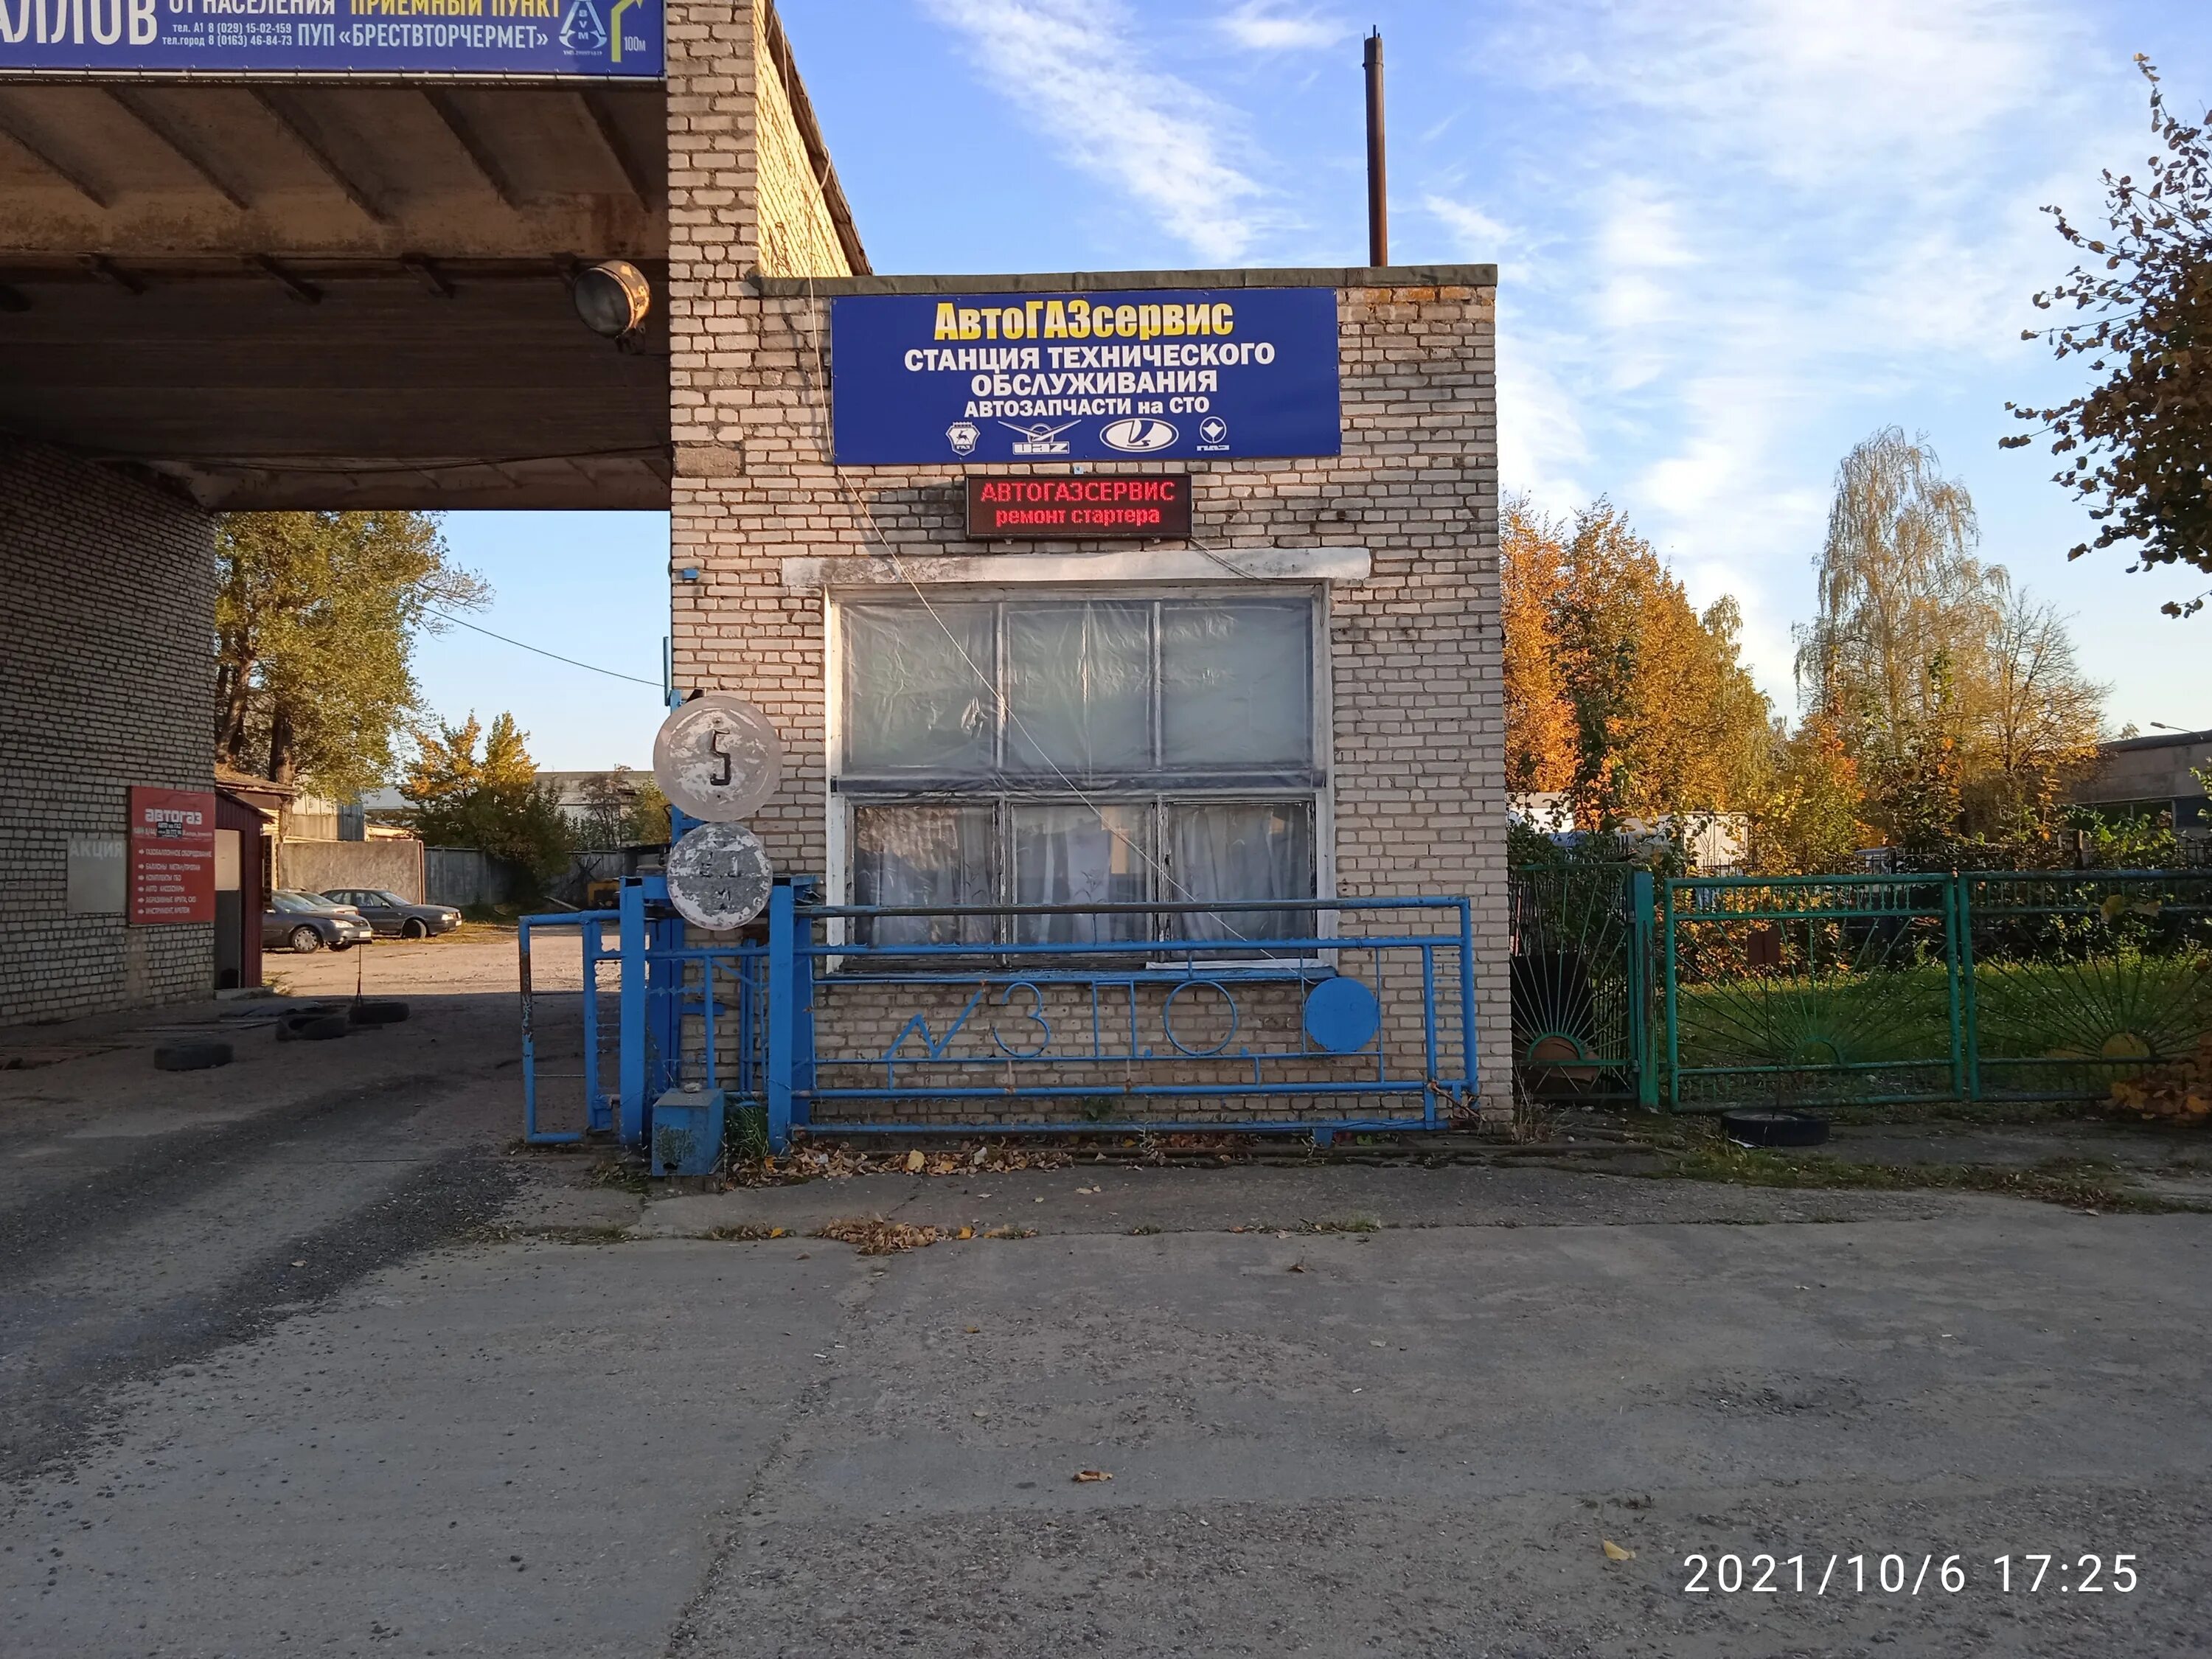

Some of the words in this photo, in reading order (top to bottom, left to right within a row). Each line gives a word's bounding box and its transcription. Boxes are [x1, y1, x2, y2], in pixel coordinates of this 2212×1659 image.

[203, 0, 335, 14] НАСЕЛЕНИЯ
[173, 24, 190, 32] тел.
[208, 23, 214, 32] 8
[218, 23, 243, 34] (029)
[246, 23, 292, 33] 15-02-159
[298, 24, 335, 46] ПУП
[339, 24, 549, 48] «БРЕСТВТОРЧЕРМЕТ»
[208, 35, 214, 45] 8
[218, 35, 248, 47] (0163)
[250, 35, 292, 45] 46-84-73
[933, 300, 1234, 341] АвтоГАЗсервис
[904, 347, 1034, 373] СТАНЦИЯ
[1047, 341, 1276, 369] ТЕХНИЧЕСКОГО
[970, 369, 1218, 397] ОБСЛУЖИВАНИЯ
[964, 397, 1131, 419] АВТОЗАПЧАСТИ
[1138, 400, 1164, 415] на
[1169, 396, 1210, 414] СТО
[980, 481, 1175, 502] АВТОГАЗСЕРВИС
[995, 509, 1066, 527] ремонт
[1071, 507, 1160, 526] стартера
